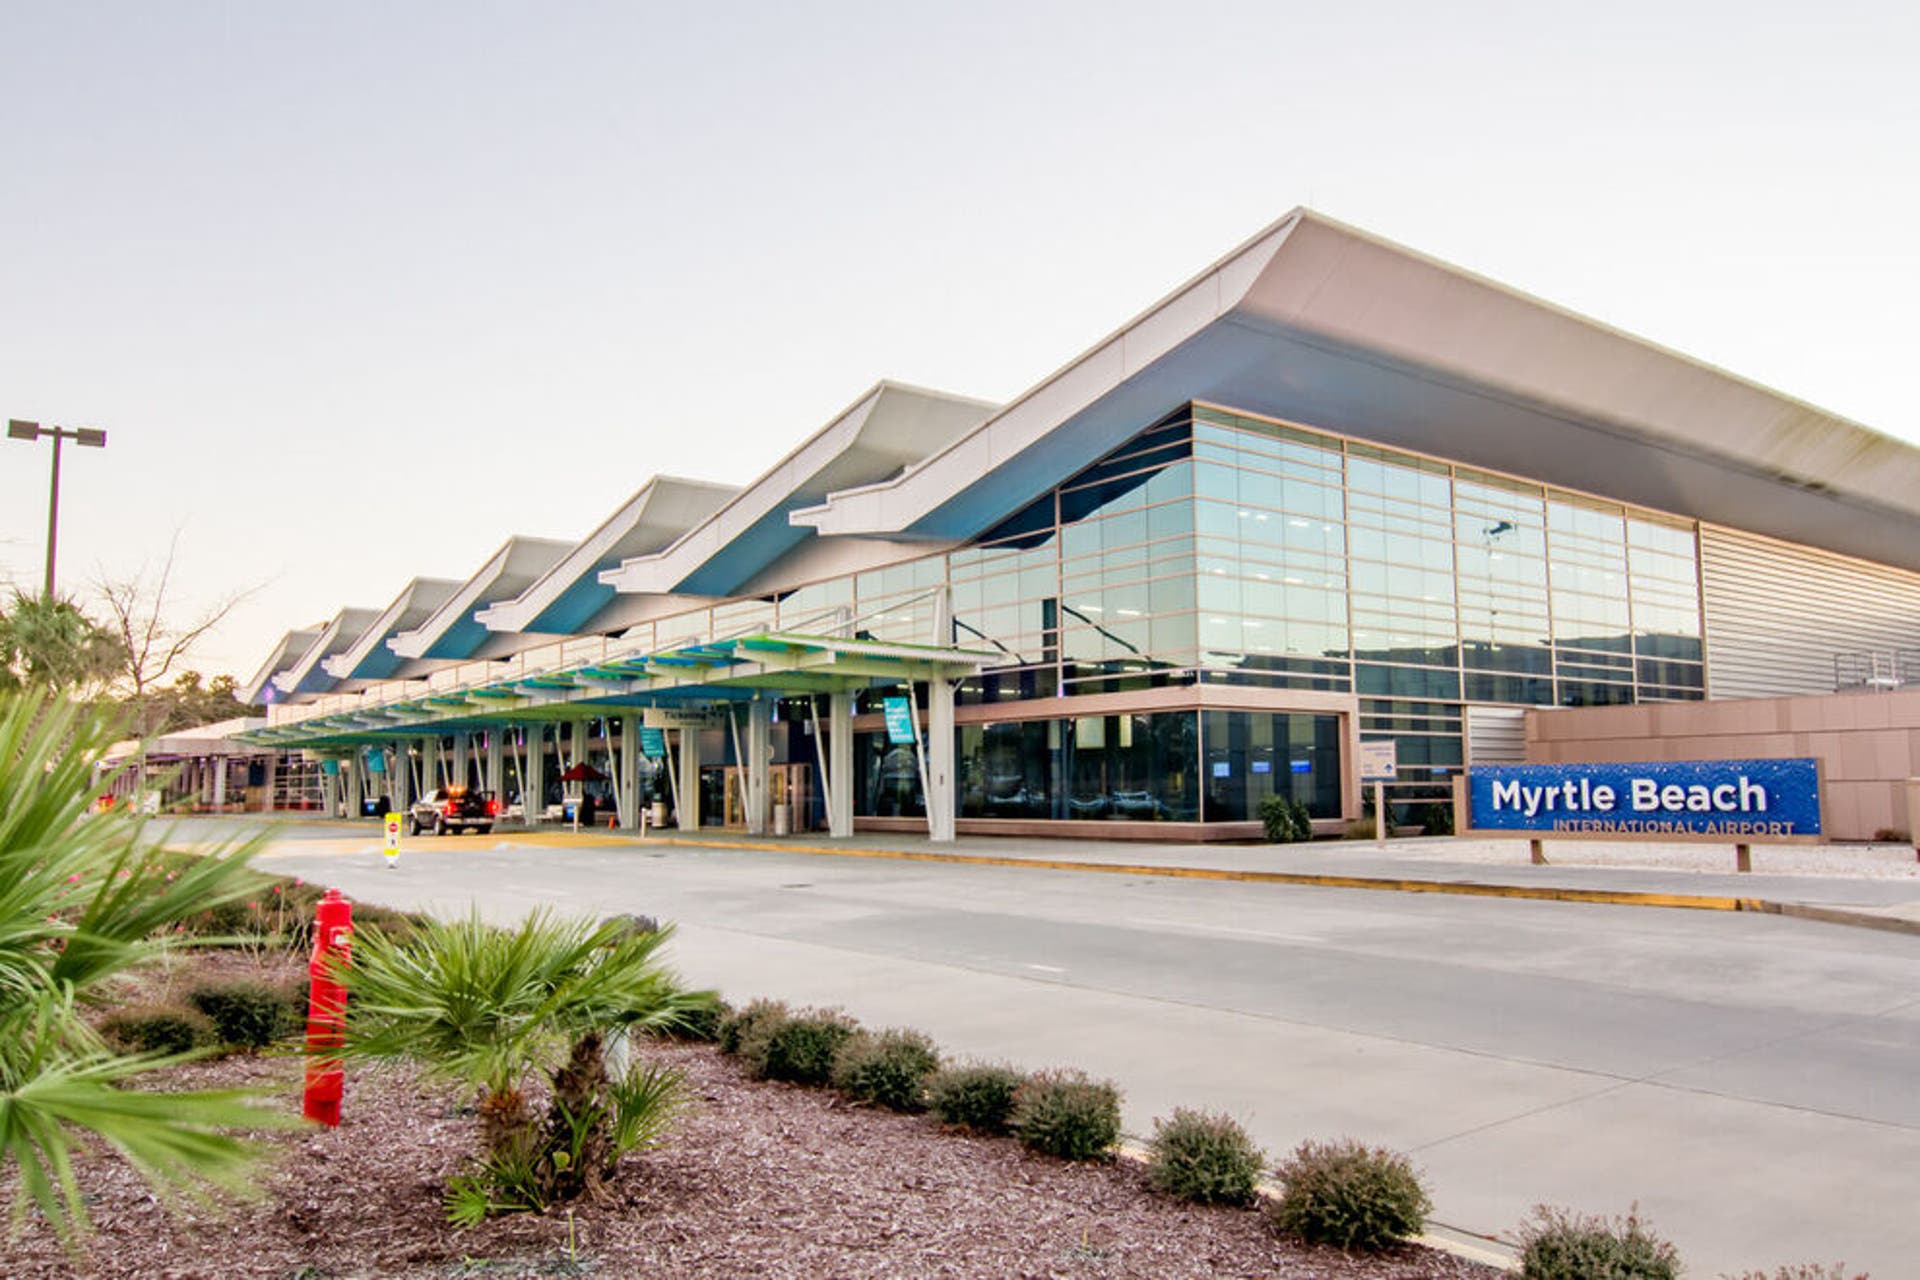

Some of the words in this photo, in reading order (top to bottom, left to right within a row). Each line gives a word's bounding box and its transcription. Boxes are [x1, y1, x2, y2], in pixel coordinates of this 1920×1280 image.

[1492, 778, 1616, 817] Myrtle
[1631, 776, 1767, 811] Beach
[1553, 819, 1697, 833] INTERNATIONAL
[1704, 821, 1795, 836] AIRPORT
